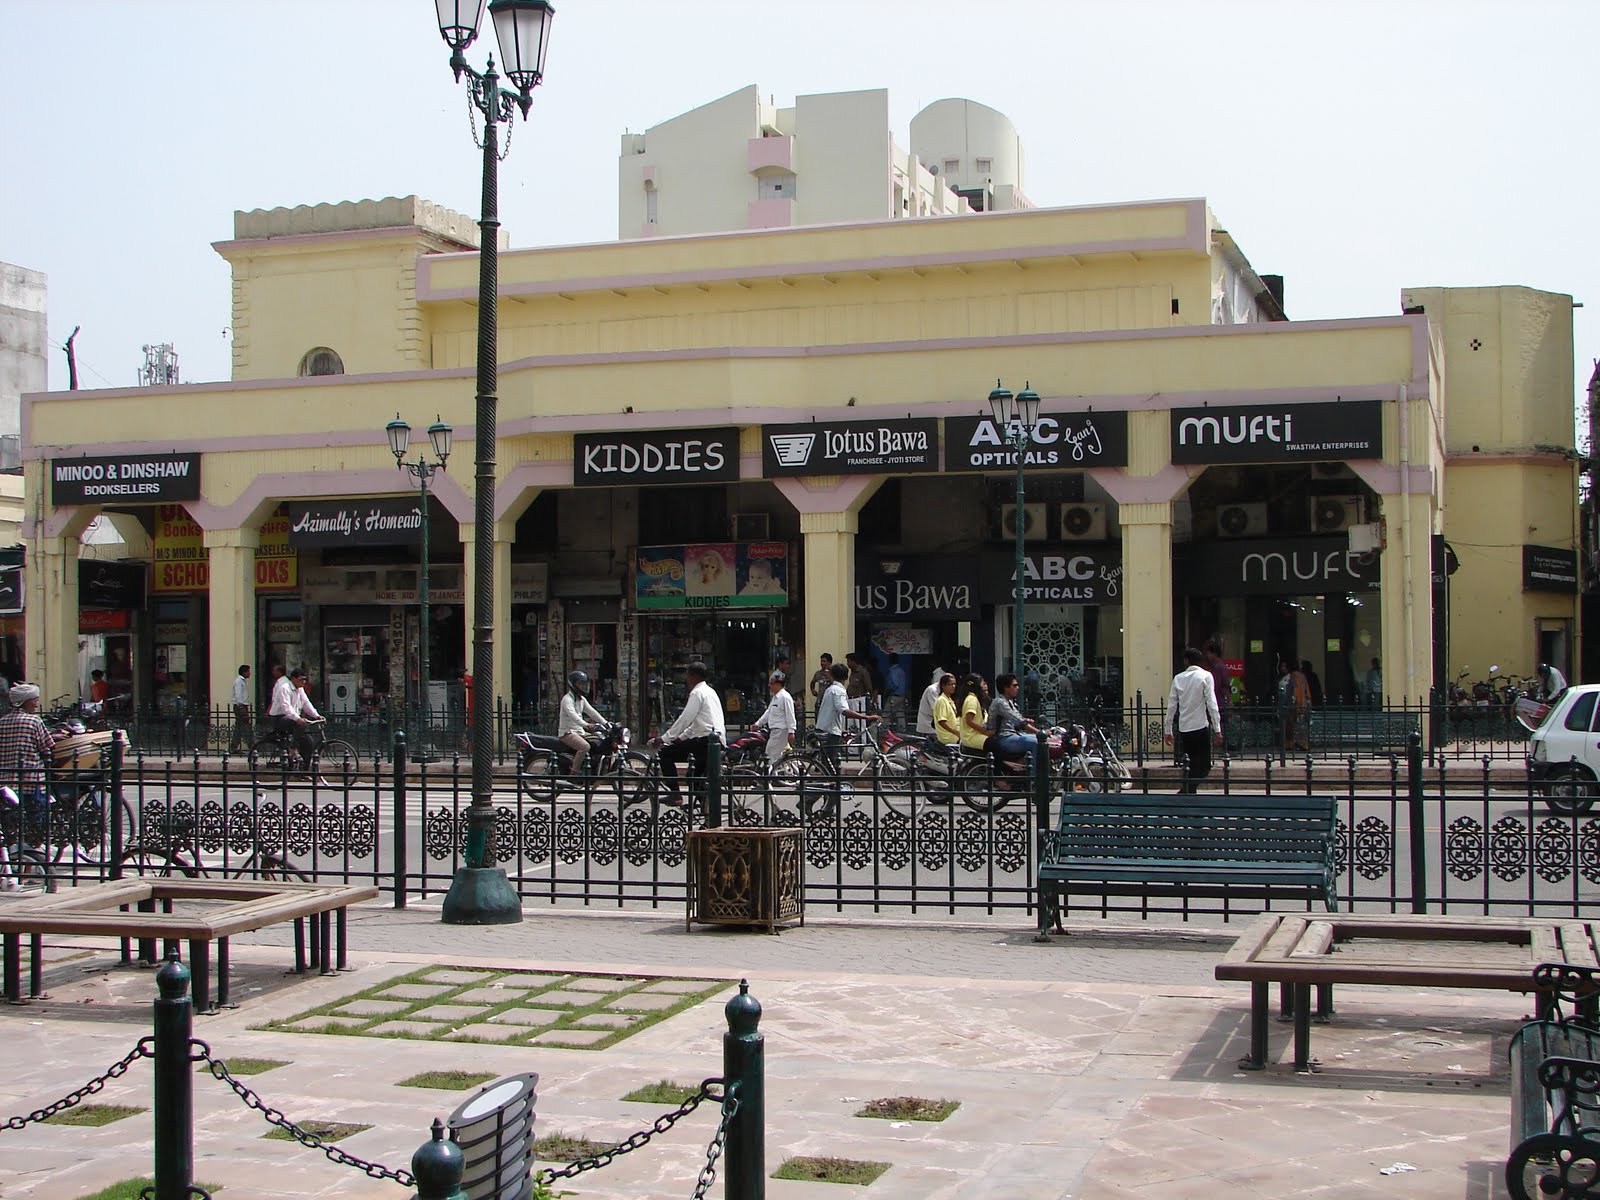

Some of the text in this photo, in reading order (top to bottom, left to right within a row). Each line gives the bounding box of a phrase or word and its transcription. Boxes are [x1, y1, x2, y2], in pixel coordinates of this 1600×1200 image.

[1179, 414, 1292, 445] mufti
[824, 428, 928, 458] Lotus Bawa
[1322, 442, 1369, 450] ENTERPRISES
[584, 441, 725, 474] KIDDIES
[56, 462, 189, 481] MINOO & DINSHAW
[84, 483, 160, 496] BOOKSELLERS
[293, 510, 361, 536] Azimally's
[172, 547, 196, 559] MINOO
[163, 562, 210, 587] SCHO
[256, 559, 289, 584] OKS
[1011, 556, 1095, 581] ABC
[515, 591, 543, 599] PHILIPS
[685, 595, 730, 608] KIDDIES
[855, 579, 971, 614] us Bawa
